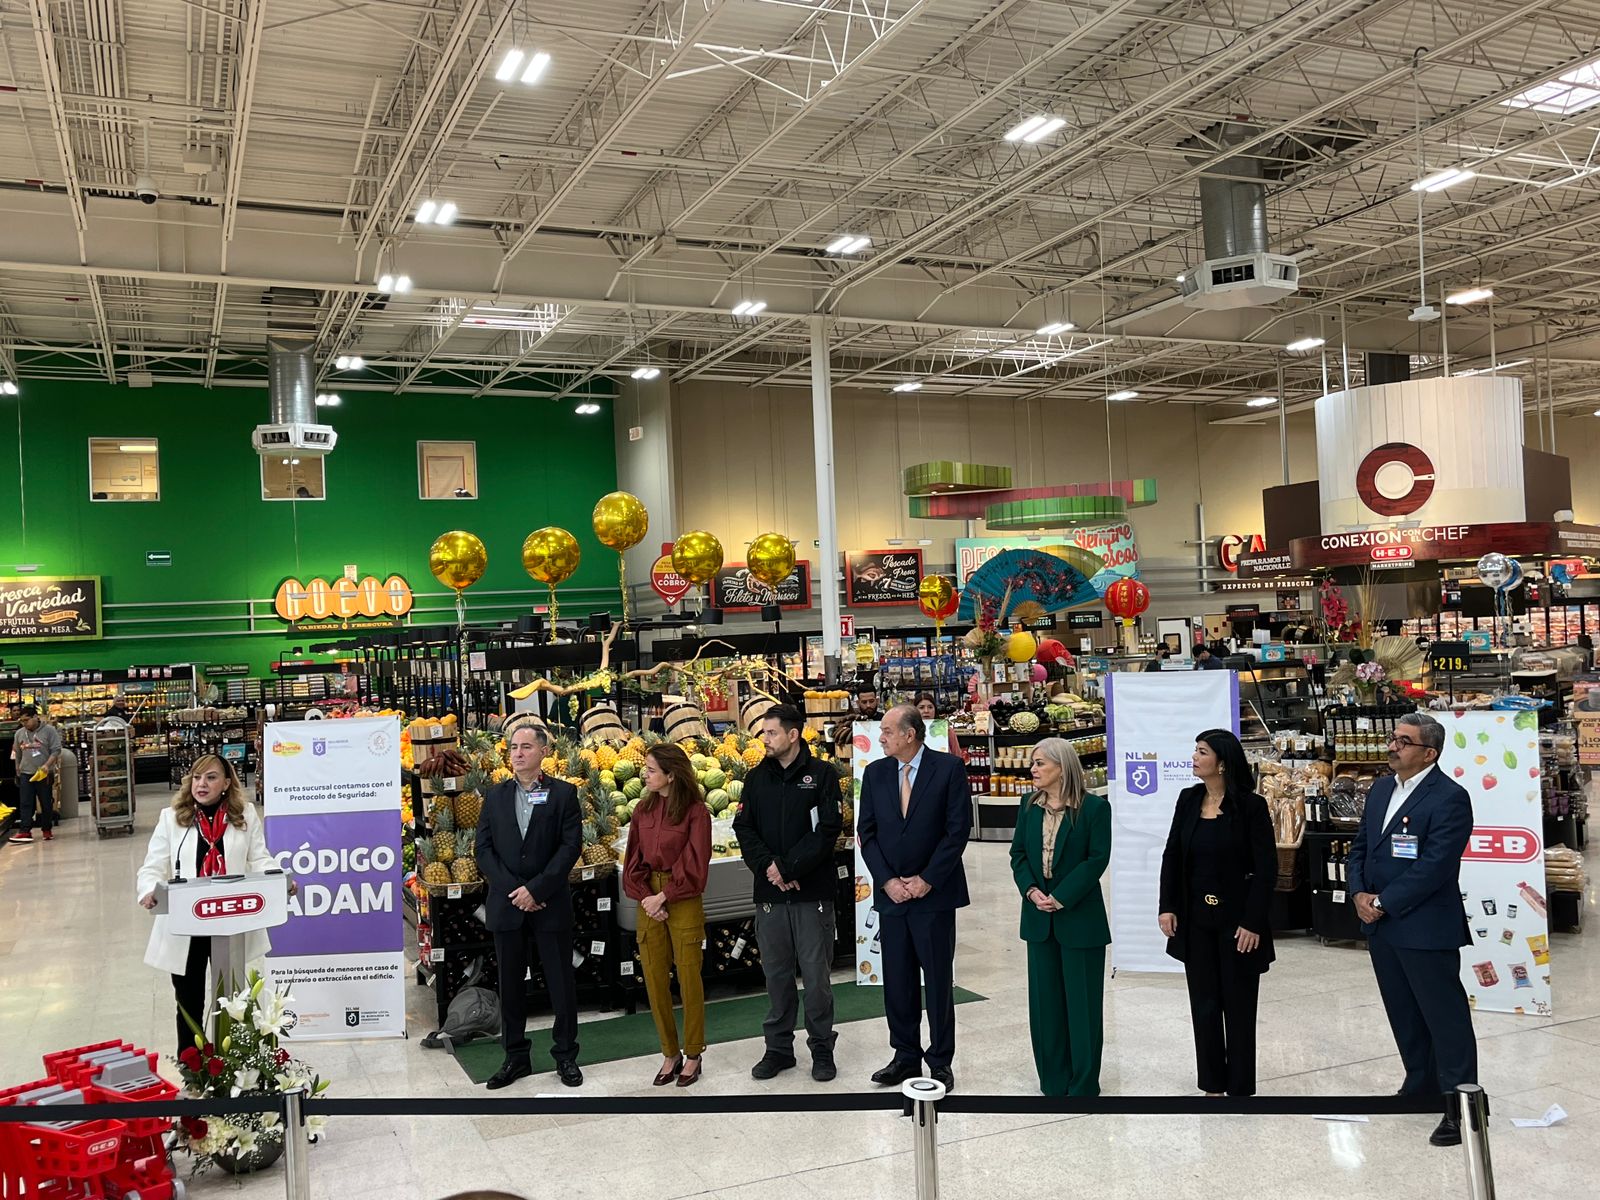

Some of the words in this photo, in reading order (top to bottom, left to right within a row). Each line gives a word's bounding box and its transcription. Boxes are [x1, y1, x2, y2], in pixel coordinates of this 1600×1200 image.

[1322, 530, 1402, 550] CONEXION
[1422, 526, 1469, 542] CHEF
[882, 554, 916, 570] Pescado
[1254, 562, 1291, 572] NACIONALE
[892, 568, 916, 579] Fresco
[0, 586, 42, 603] resca
[6, 588, 86, 617] Variedad
[285, 579, 403, 616] HUEVO
[724, 588, 754, 603] Filetes
[338, 791, 377, 800] Seguridad:
[1470, 836, 1527, 854] E-B
[274, 842, 394, 874] CÓDIGO
[201, 898, 257, 914] H-E-B
[287, 882, 392, 916] ADAM
[294, 968, 325, 976] búsqueda
